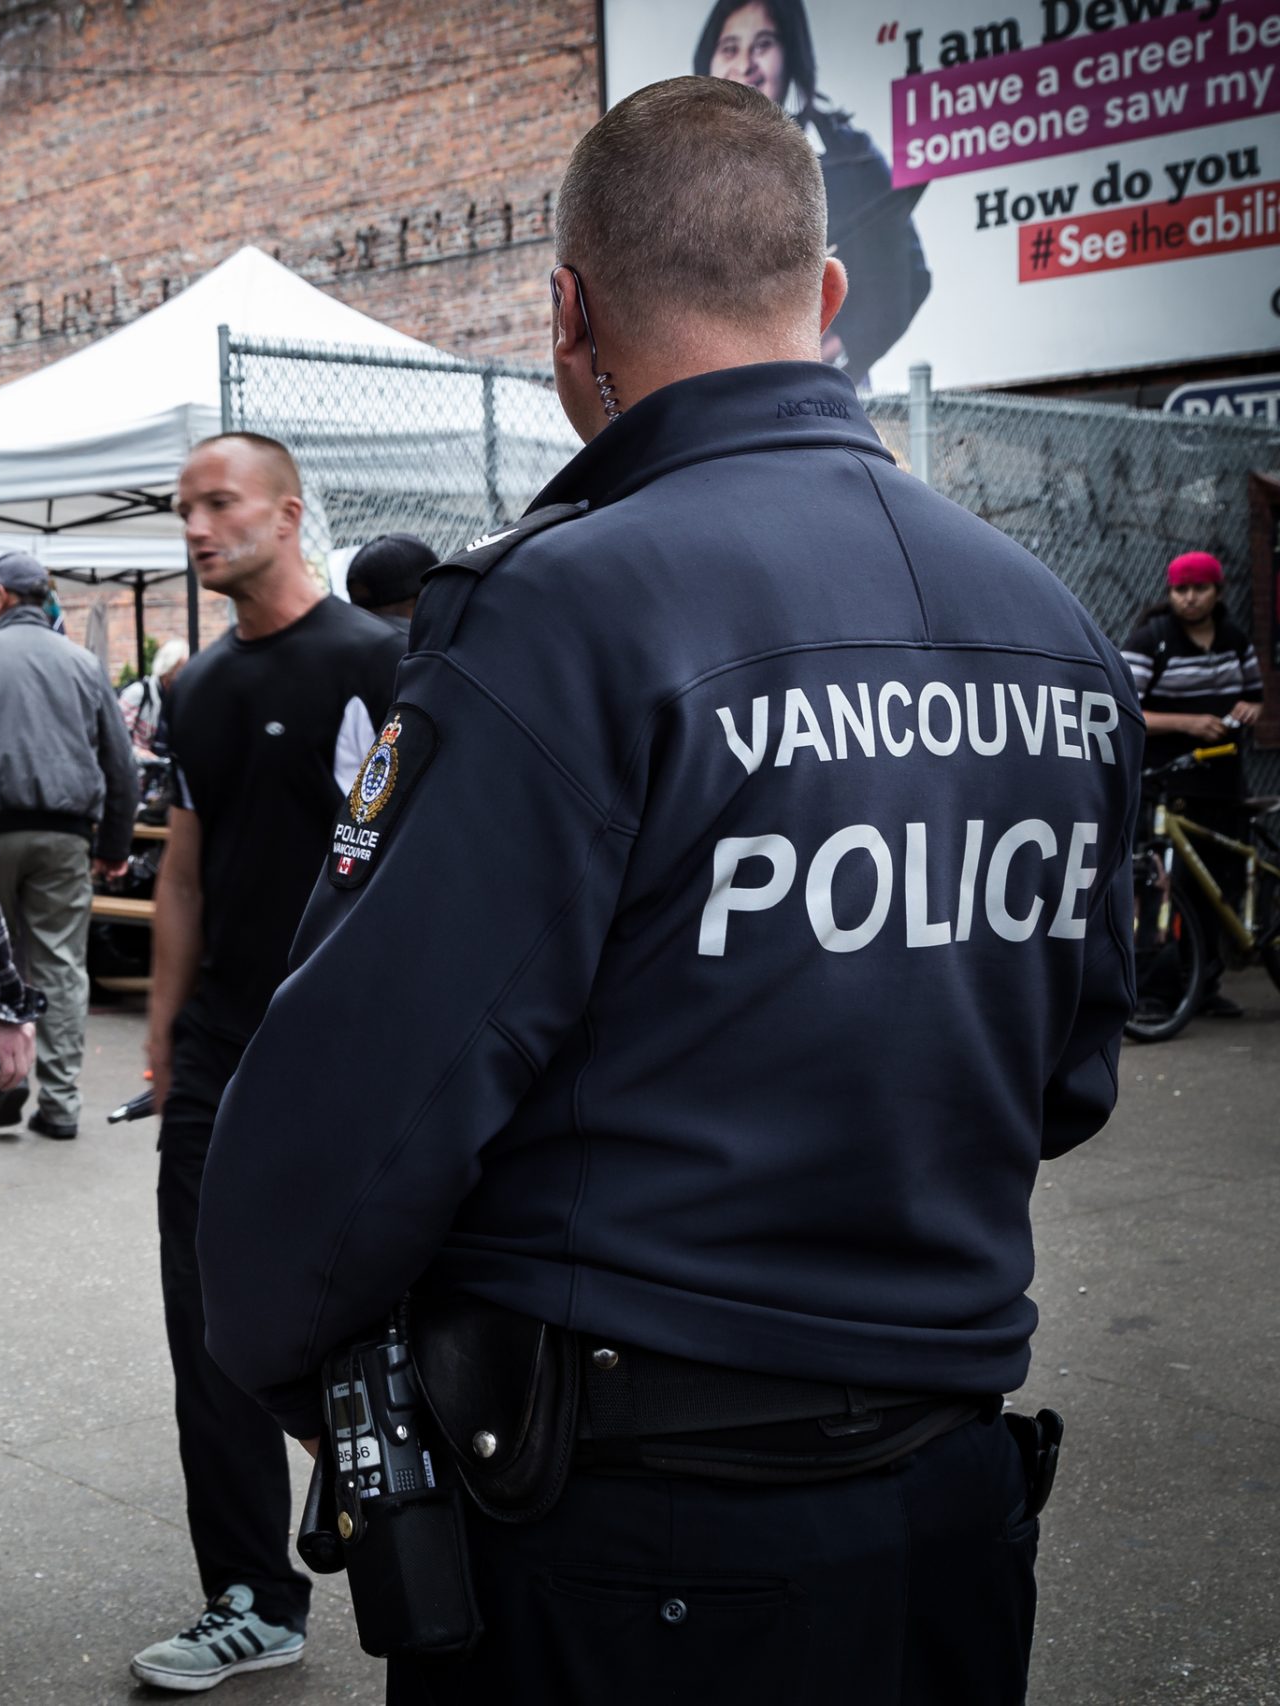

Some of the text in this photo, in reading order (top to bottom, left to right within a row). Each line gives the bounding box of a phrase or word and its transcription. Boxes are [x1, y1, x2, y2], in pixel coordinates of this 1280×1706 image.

[906, 89, 917, 126] I
[930, 75, 1023, 121] have
[1036, 65, 1060, 98] a
[1073, 29, 1214, 88] career
[939, 17, 1023, 69] am
[906, 63, 1275, 169] someone saw my
[975, 145, 1261, 231] How do you
[716, 680, 1120, 776] VANCOUVER
[333, 842, 371, 861] VANCOUVER
[334, 824, 379, 848] POLICE
[697, 818, 1099, 957] POLICE
